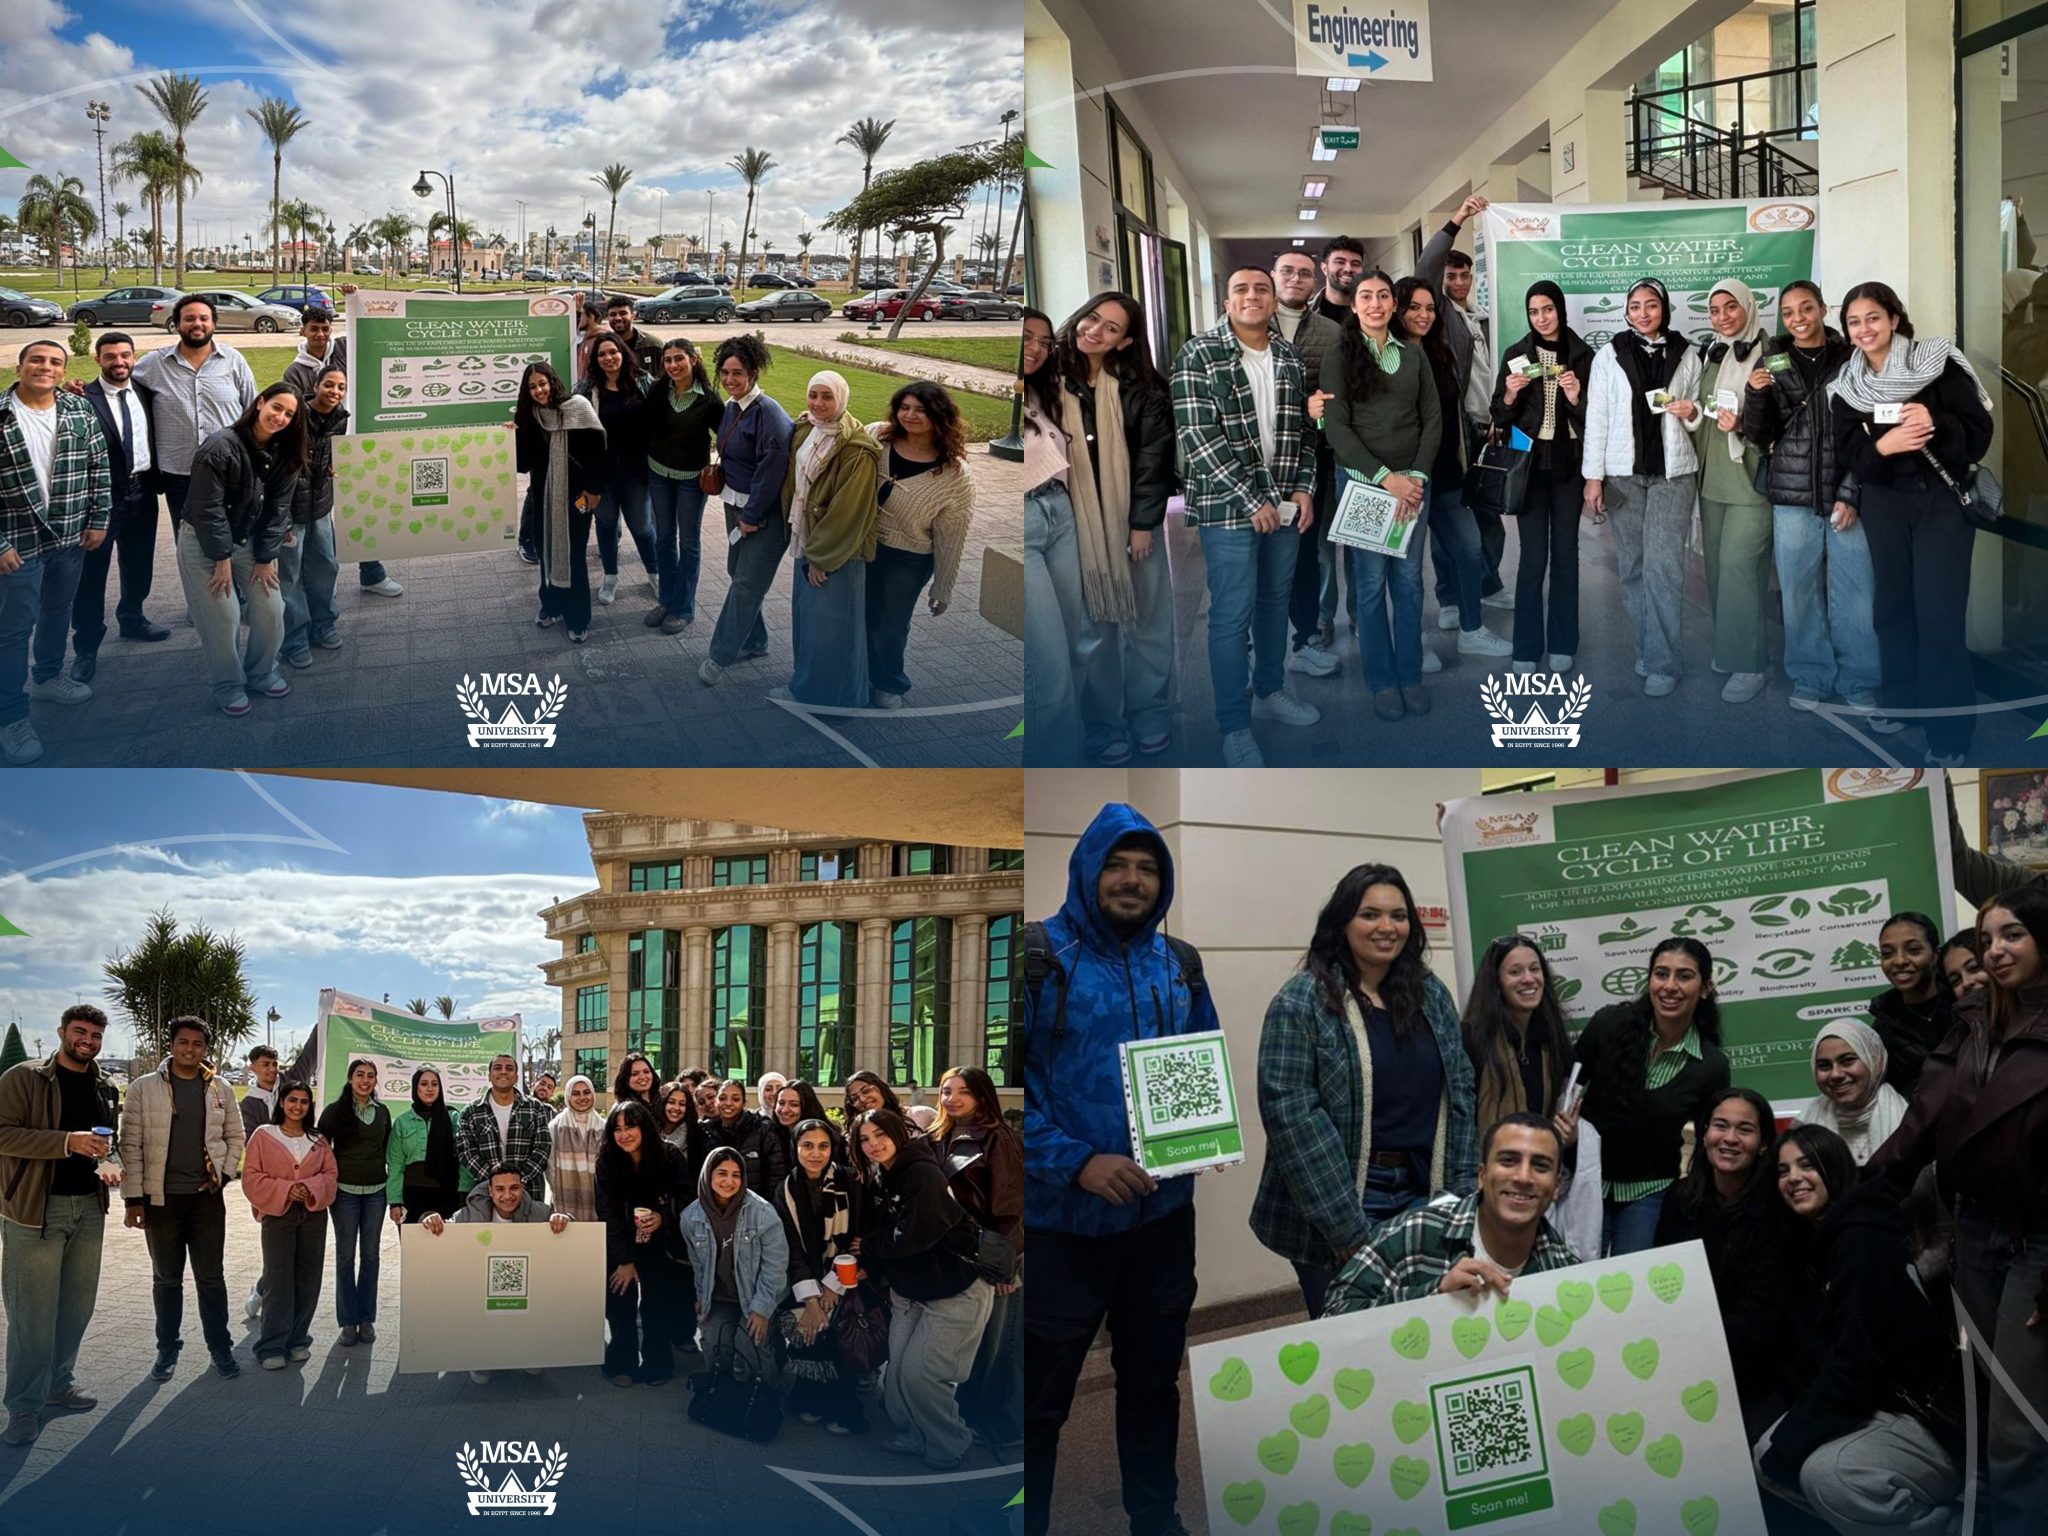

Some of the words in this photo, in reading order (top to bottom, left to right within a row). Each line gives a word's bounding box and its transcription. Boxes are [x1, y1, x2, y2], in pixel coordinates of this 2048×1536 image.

[1307, 4, 1419, 59] Engineering
[1560, 242, 1642, 256] CLEAN
[1651, 239, 1744, 252] WATER,
[1563, 255, 1640, 268] CYCLE
[1646, 254, 1681, 265] OF
[1690, 251, 1744, 264] LIFE
[1561, 271, 1573, 279] US
[1576, 271, 1587, 279] IN
[1589, 270, 1644, 278] EXPLORING
[1648, 268, 1710, 277] INNOVATIVE
[1712, 266, 1773, 274] SOLUTIONS
[1561, 278, 1628, 286] SUSTAINABLE
[405, 321, 463, 329] CLEAN
[468, 320, 528, 328] WATER,
[407, 329, 461, 338] CYCLE
[466, 329, 489, 337] OF
[494, 328, 528, 336] LIFE
[1489, 813, 1525, 823] MSA
[1557, 835, 1675, 863] CLEAN
[1688, 815, 1825, 846] WATER,
[1562, 853, 1673, 880] CYCLE
[1683, 844, 1734, 865] OF
[1747, 831, 1825, 857] LIFE
[1525, 891, 1558, 900] JOIN
[1562, 888, 1580, 897] US
[1583, 886, 1598, 894] IN
[1602, 875, 1684, 892] EXPLORING
[1687, 861, 1778, 882] INNOVATIVE
[1782, 848, 1872, 868] SOLUTIONS
[1530, 902, 1560, 910] FOR
[1564, 888, 1660, 907] SUSTAINABLE
[1662, 882, 1712, 895] WATER
[1716, 865, 1827, 889] MANAGEMENT
[1832, 860, 1867, 872] AND
[1635, 886, 1749, 908] CONSERVATION
[1755, 927, 1811, 940] Recyclable
[1819, 917, 1887, 931] Conservation
[1704, 938, 1724, 947] ycle
[1547, 956, 1578, 964] llution
[1844, 974, 1876, 982] Forest
[1760, 981, 1816, 992] Biodiversity
[1808, 1003, 1852, 1016] SPARK
[371, 1032, 421, 1045] CYCLE
[425, 1039, 446, 1047] OF
[451, 1040, 481, 1048] LIFE
[1767, 1042, 1804, 1052] FOR
[1167, 1143, 1197, 1157] Scan
[1471, 1500, 1503, 1515] Scan
[1506, 1491, 1529, 1508] me!
